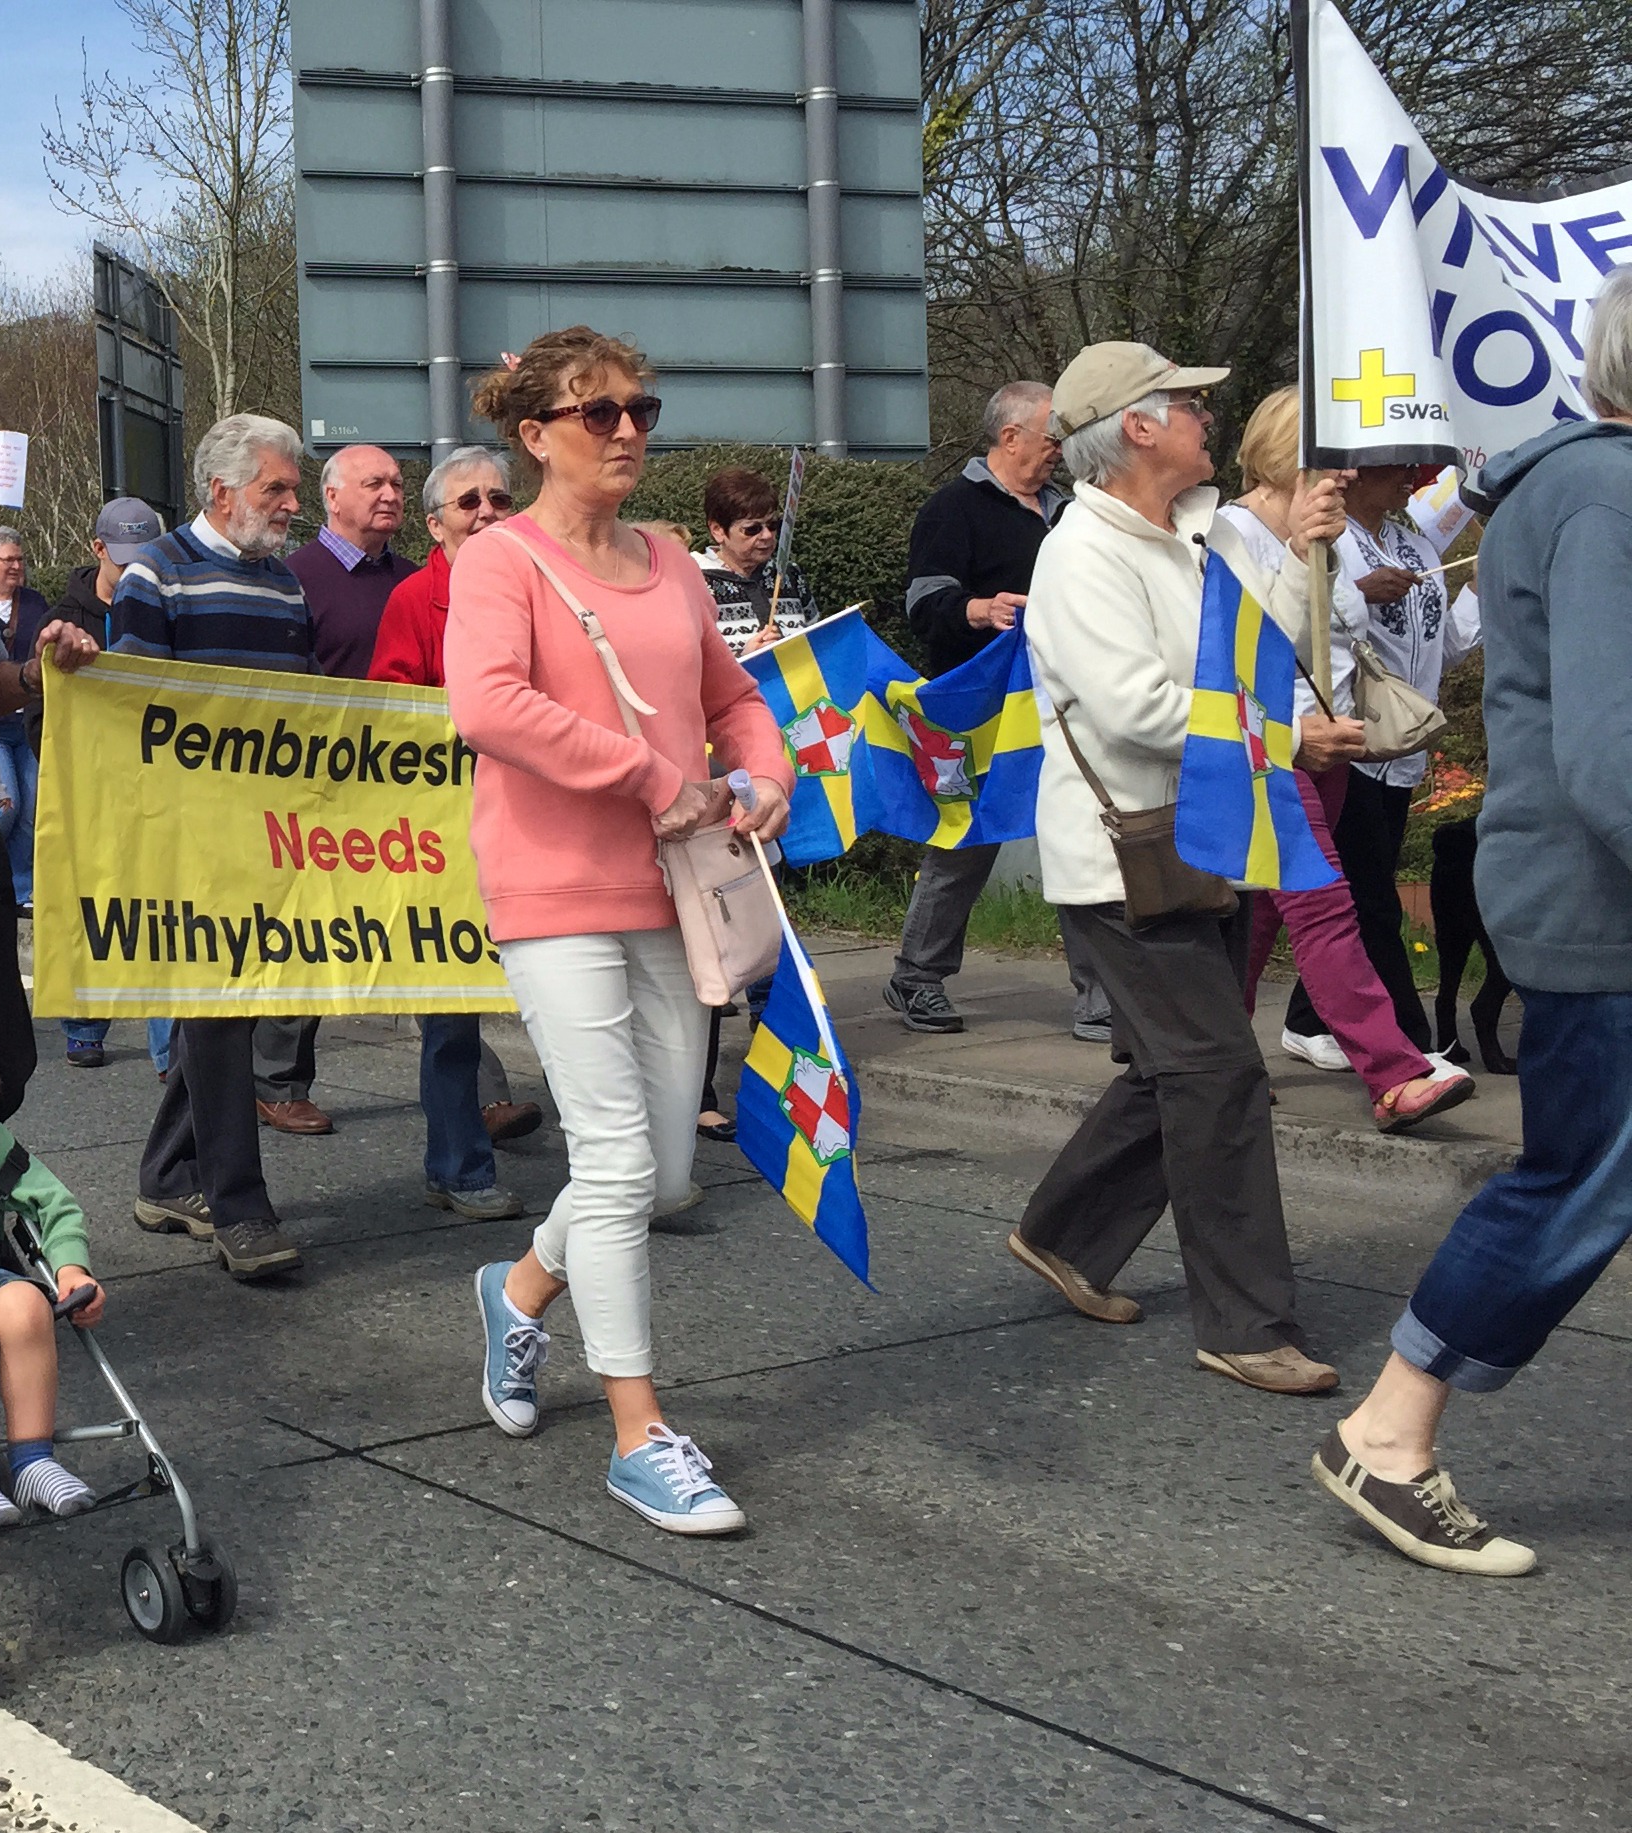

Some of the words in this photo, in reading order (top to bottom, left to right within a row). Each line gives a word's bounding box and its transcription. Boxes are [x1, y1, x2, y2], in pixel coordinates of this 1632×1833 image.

[141, 704, 478, 786] Pembrokesh
[264, 811, 446, 874] Needs
[80, 897, 392, 977] Withybush
